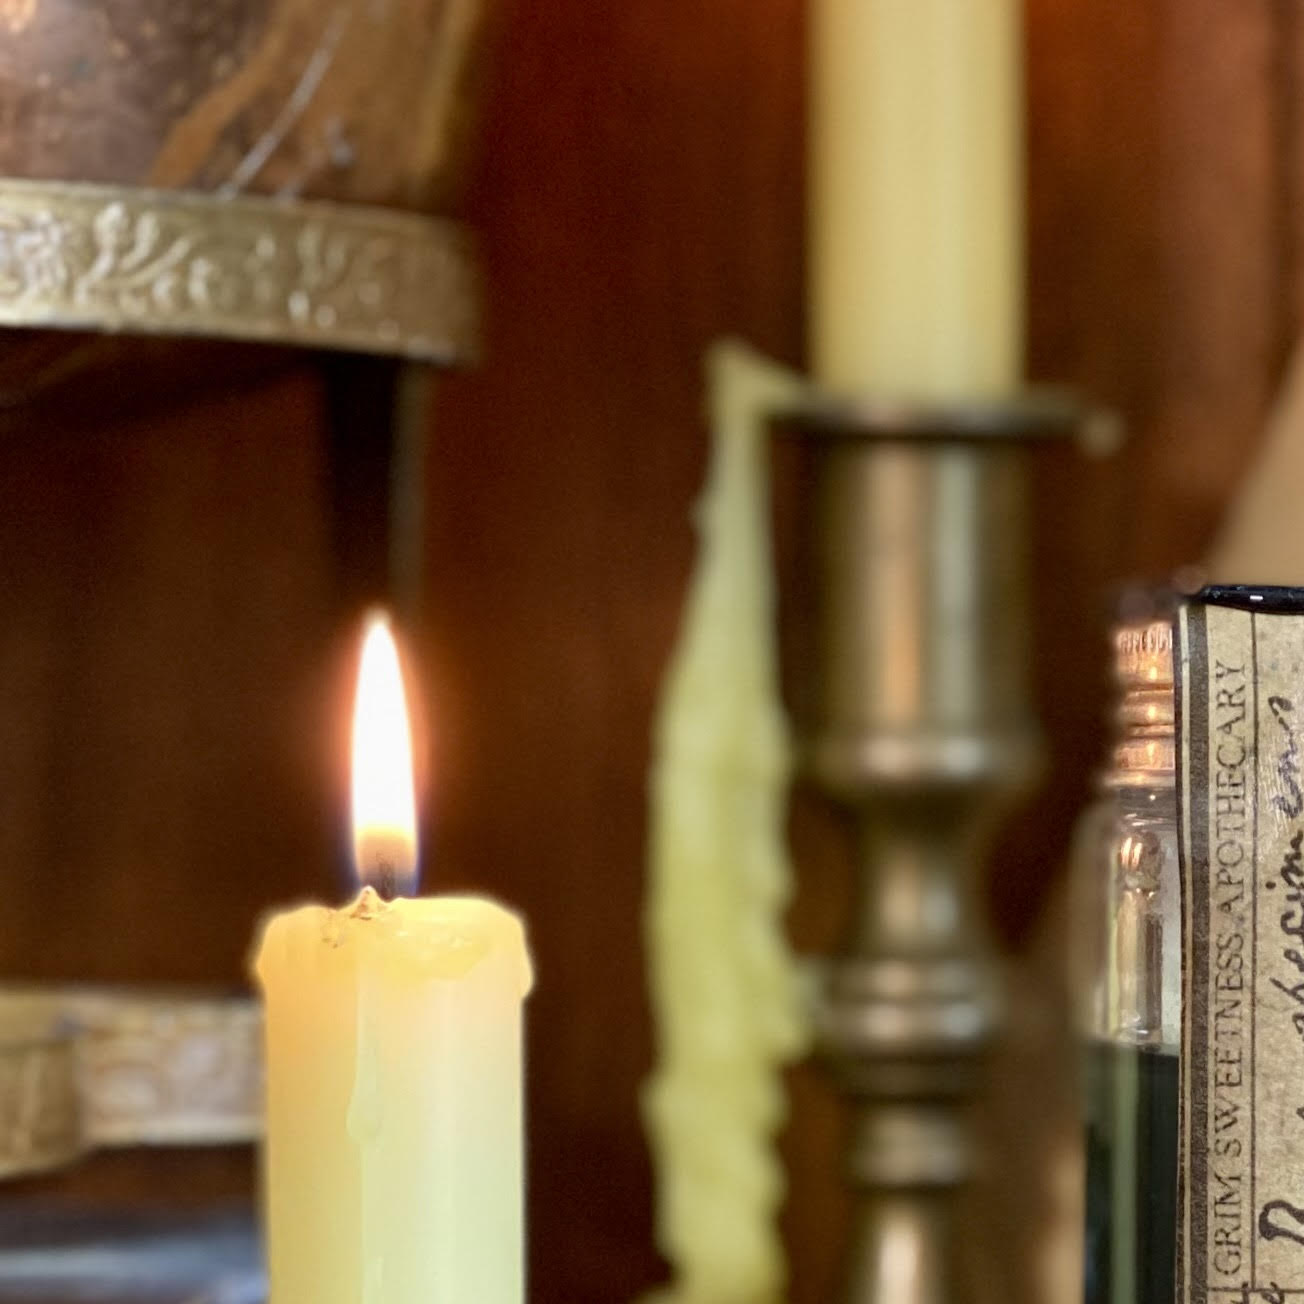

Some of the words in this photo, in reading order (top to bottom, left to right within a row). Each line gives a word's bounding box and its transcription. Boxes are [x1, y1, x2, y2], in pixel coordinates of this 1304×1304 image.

[1214, 659, 1248, 914] APOTHECARY
[1213, 931, 1245, 1158] SWEETNESS
[1213, 1170, 1243, 1275] GRIM
